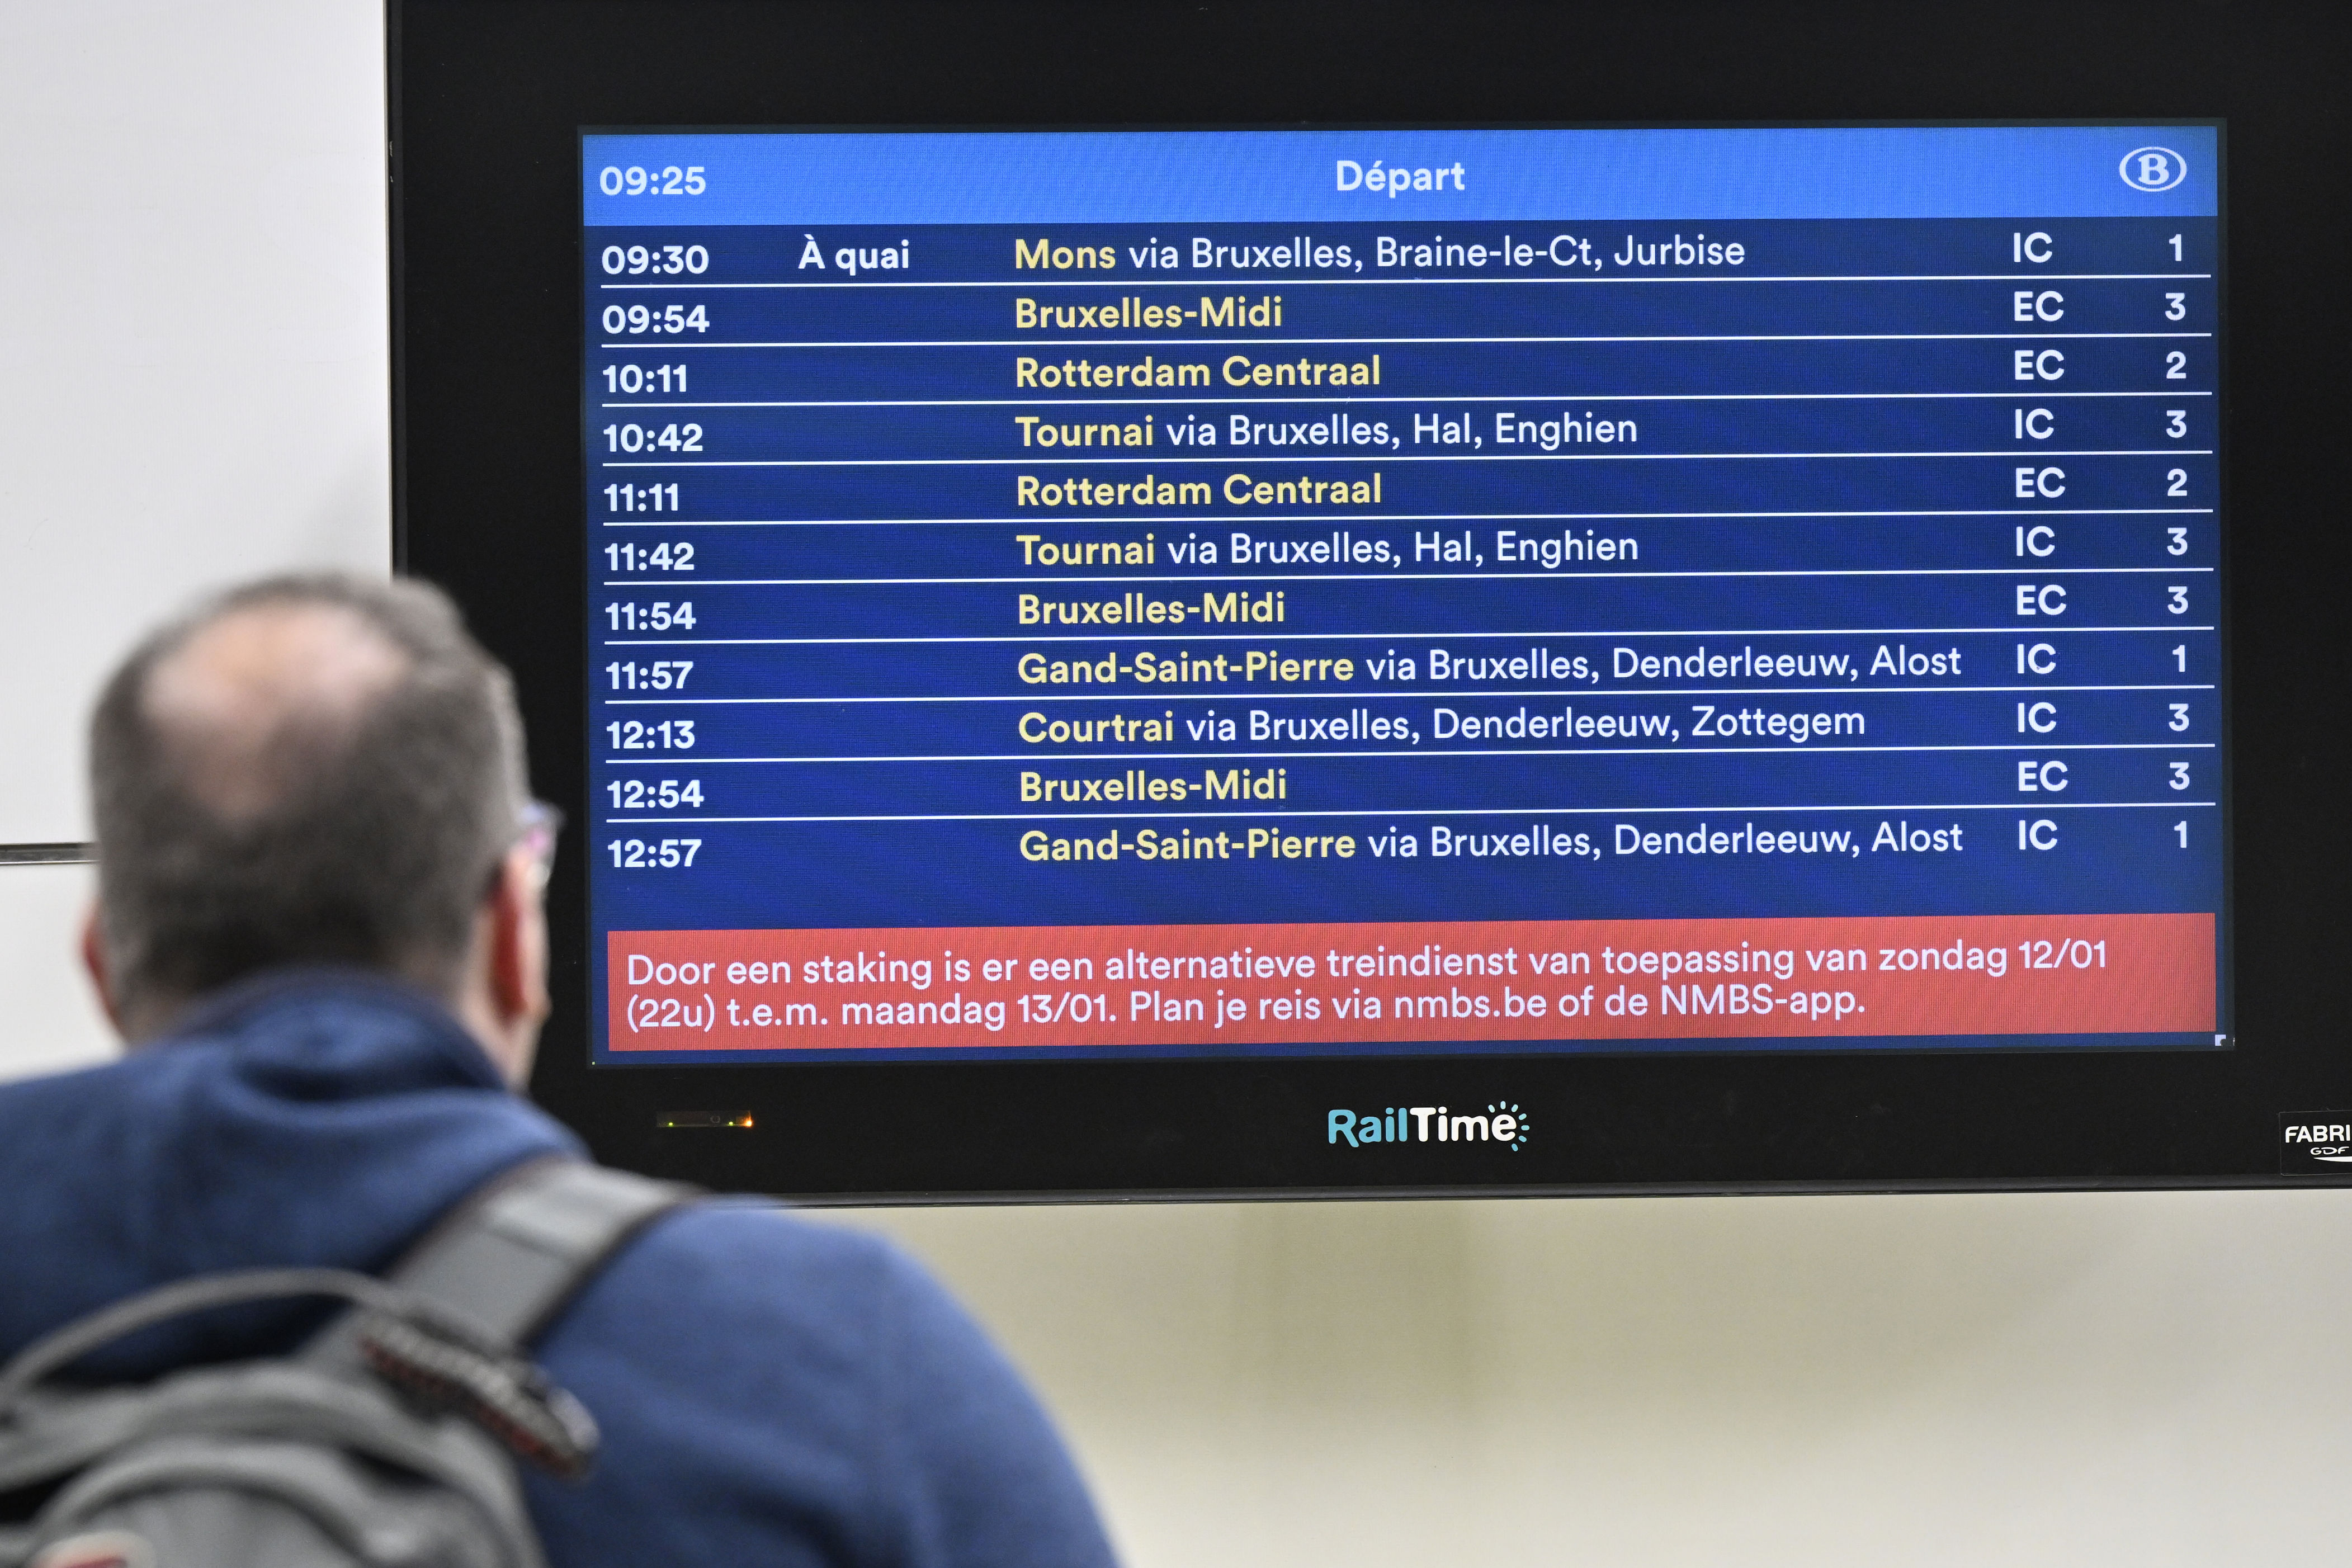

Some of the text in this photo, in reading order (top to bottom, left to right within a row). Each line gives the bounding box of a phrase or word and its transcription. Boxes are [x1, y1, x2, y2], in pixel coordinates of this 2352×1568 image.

[600, 166, 706, 196] 09:25
[1336, 160, 1465, 199] Départ
[602, 245, 709, 275] 09:30
[799, 234, 909, 276] À quai
[1016, 234, 1745, 272] Mons via Bruxelles, Braine-le-Ct, Jurbise
[2014, 232, 2052, 263] IC
[2169, 234, 2181, 261] 1
[602, 305, 710, 334] 09:54
[1016, 296, 1281, 328] Bruxelles-Midi
[2014, 291, 2063, 322] EC
[2165, 293, 2185, 320] 3
[603, 365, 686, 393] 10:11
[1017, 355, 1380, 388] Rotterdam Centraal
[2015, 350, 2064, 380] EC
[2166, 351, 2186, 379] 2
[603, 423, 703, 452] 10:42
[1014, 412, 1637, 451] Tournai via Bruxelles, Hal, Enghien
[2015, 408, 2053, 439] IC
[2166, 410, 2186, 438] 3
[604, 483, 678, 512] 11:11
[1018, 473, 1381, 506] Rotterdam Centraal
[2016, 467, 2065, 498] EC
[2167, 469, 2187, 496] 2
[1016, 530, 1637, 569] Tournai via Bruxelles, Hal, Enghien
[2016, 526, 2055, 556] IC
[2167, 527, 2188, 555] 3
[604, 542, 695, 571] 11:42
[1019, 591, 1284, 624] Bruxelles-Midi
[2017, 584, 2066, 615] EC
[2168, 586, 2188, 614] 3
[606, 602, 696, 630] 11:54
[1018, 645, 1961, 684] Gand-Saint-Pierre via Bruxelles, Denderleeuw, Alost
[2018, 643, 2056, 674] IC
[2172, 645, 2185, 672] 1
[606, 661, 693, 689] 11:57
[1018, 706, 1864, 744] Courtrai via Bruxelles, Denderleeuw, Zottegem
[2018, 702, 2056, 733] IC
[2169, 703, 2189, 731] 3
[607, 720, 695, 749] 12:13
[1021, 768, 1286, 802] Bruxelles-Midi
[2018, 761, 2068, 791] EC
[2169, 762, 2190, 790] 3
[607, 780, 704, 809] 12:54
[1020, 821, 1963, 861] Gand-Saint-Pierre via Bruxelles, Denderleeuw, Alost
[2019, 819, 2057, 851] IC
[2174, 821, 2187, 848] 1
[608, 839, 702, 868] 12:57
[627, 937, 2106, 990] Door een staking is er een alternatieve treindienst van toepassing van zondag 12/01
[627, 983, 1866, 1033] (22u) t.e.m. maandag 13/01. Plan je reis via nmbs.be of de NMBS-app.
[1328, 1106, 1517, 1148] RailTime
[2310, 1146, 2350, 1155] GDF
